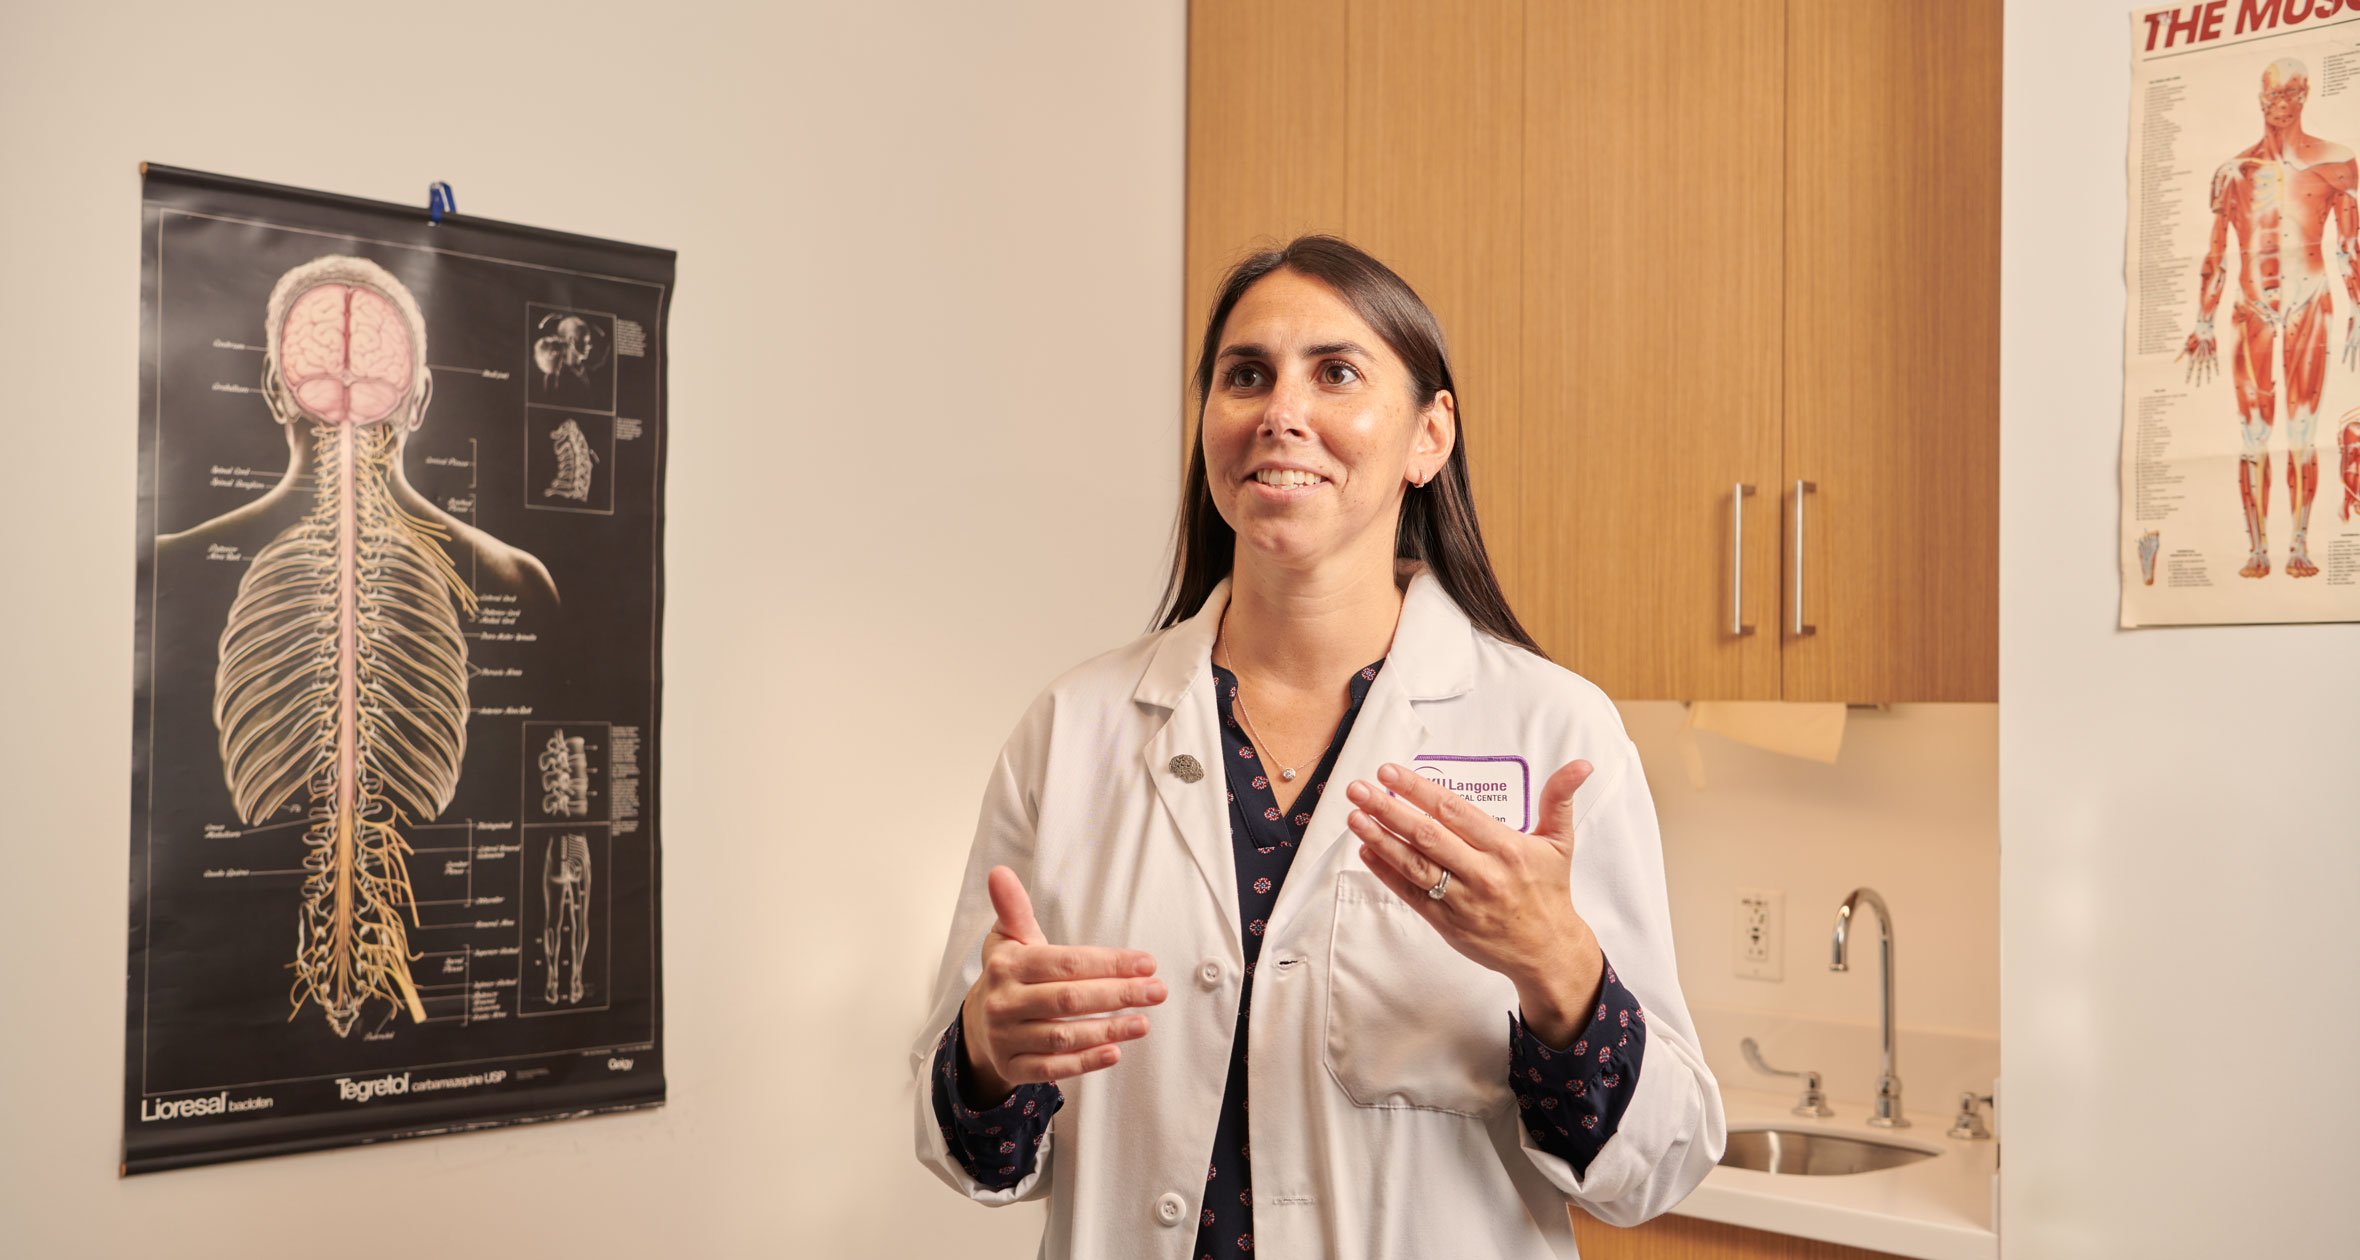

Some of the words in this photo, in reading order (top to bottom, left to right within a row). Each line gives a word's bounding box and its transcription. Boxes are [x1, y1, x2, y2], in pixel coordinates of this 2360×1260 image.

[2144, 0, 2227, 51] THE
[1449, 778, 1507, 794] Langone
[1476, 794, 1508, 802] CENTER
[335, 1072, 410, 1102] Tegretol
[484, 1070, 506, 1084] USP
[141, 1092, 227, 1122] Lioresal
